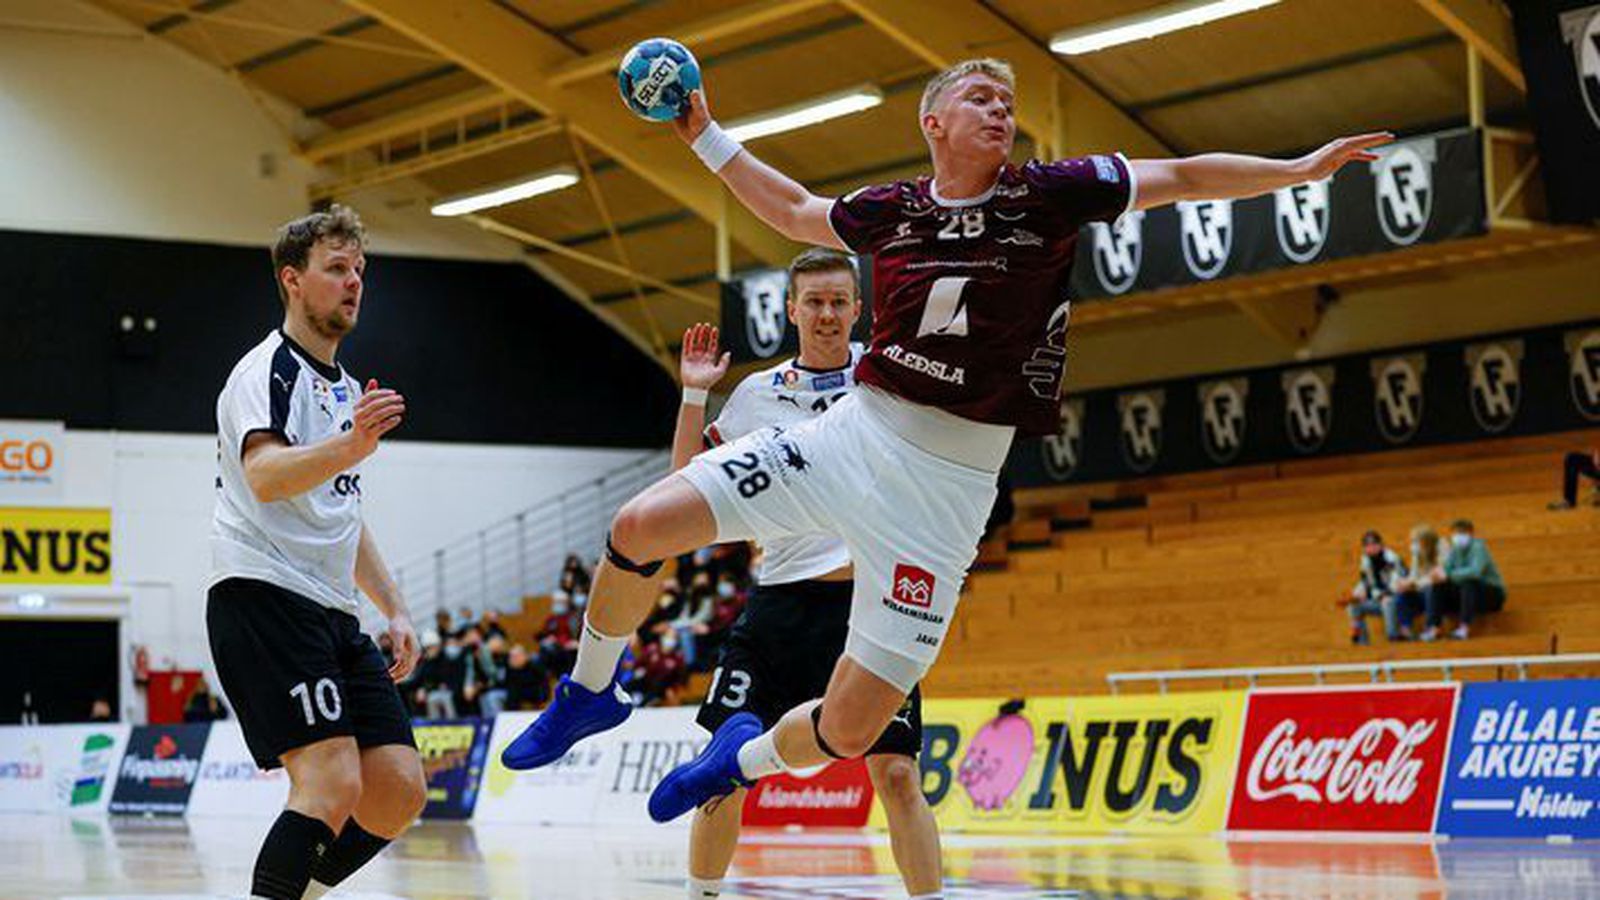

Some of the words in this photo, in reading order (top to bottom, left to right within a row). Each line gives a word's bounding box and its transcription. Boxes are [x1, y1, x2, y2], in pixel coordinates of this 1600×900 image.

[638, 60, 674, 104] SELECT
[936, 211, 986, 240] 28
[720, 451, 771, 498] 28
[1, 529, 111, 575] NUS
[289, 677, 342, 726] 10
[706, 667, 751, 708] 13
[1246, 718, 1438, 805] Coca-Cola
